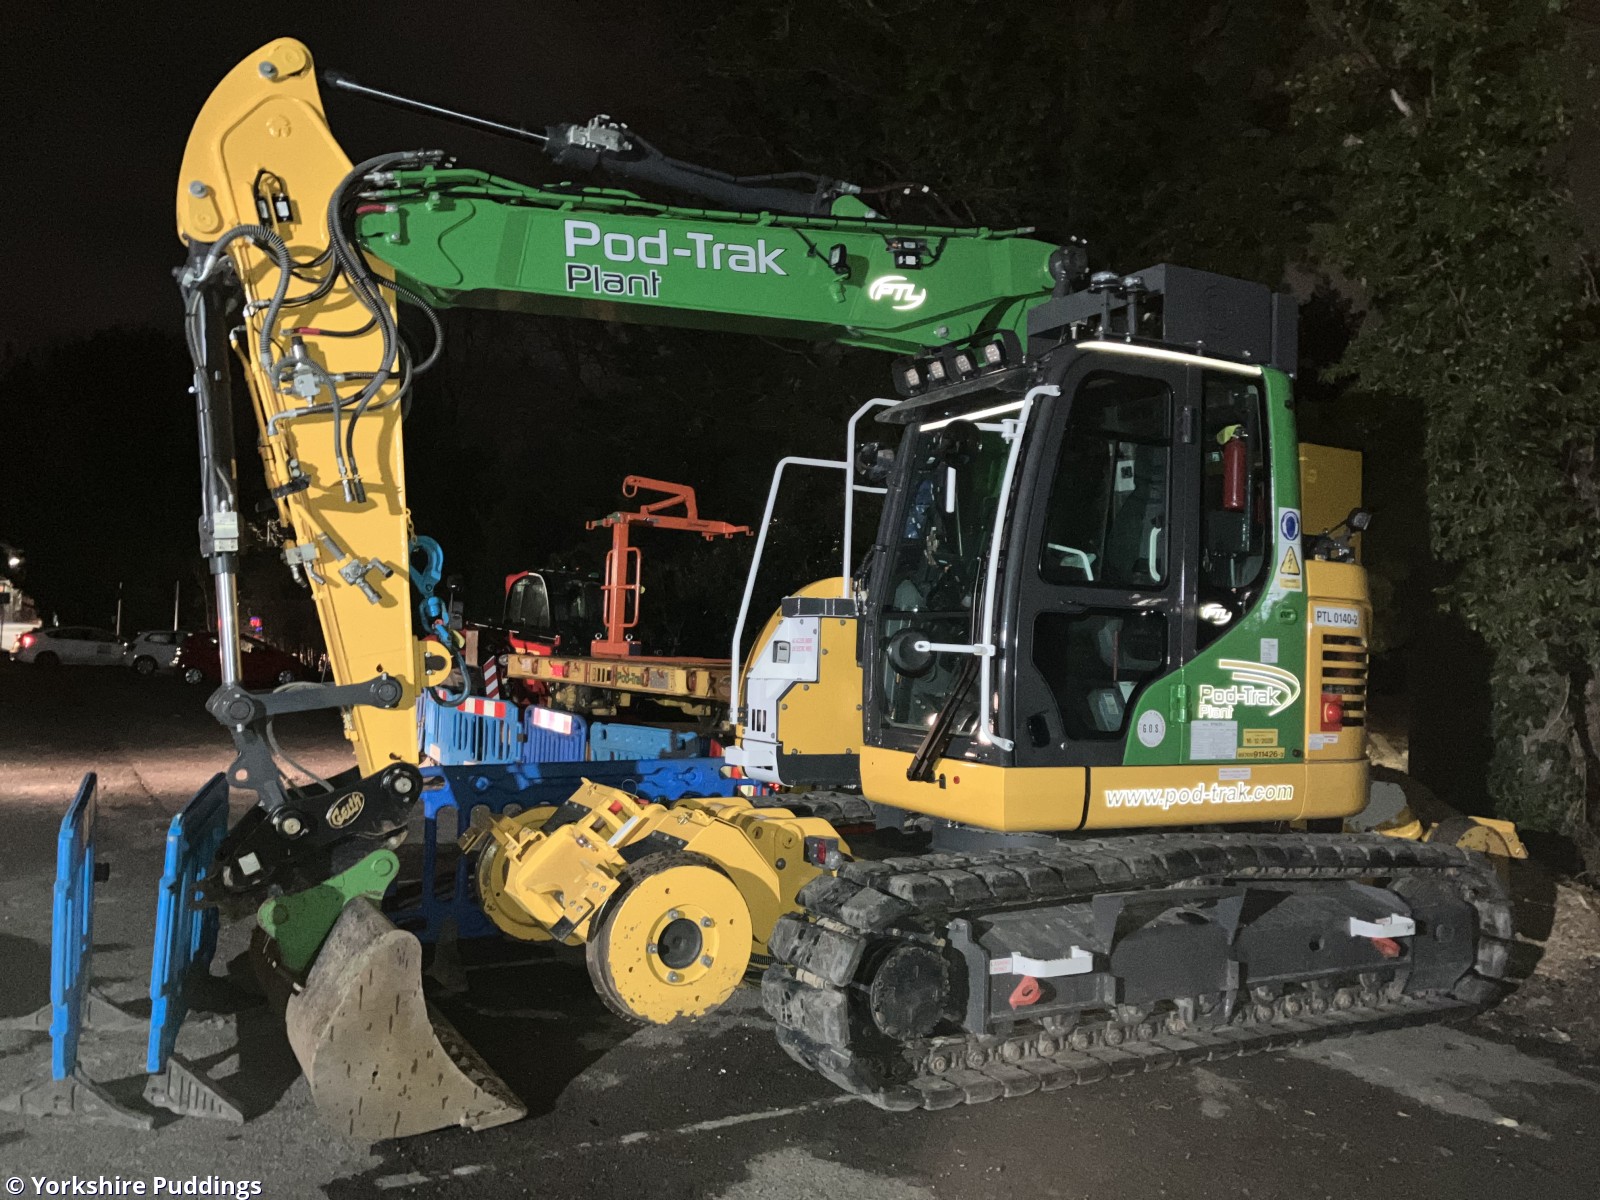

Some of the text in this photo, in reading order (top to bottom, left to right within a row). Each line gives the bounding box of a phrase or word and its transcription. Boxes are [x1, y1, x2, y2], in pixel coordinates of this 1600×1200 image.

[563, 219, 789, 276] Pod-Trak
[565, 262, 662, 298] Plant
[1316, 610, 1358, 625] PTL 0140-2
[1199, 684, 1282, 706] Pod-Trak
[1198, 704, 1235, 719] Plant
[1105, 782, 1294, 809] www.pod-trak.com
